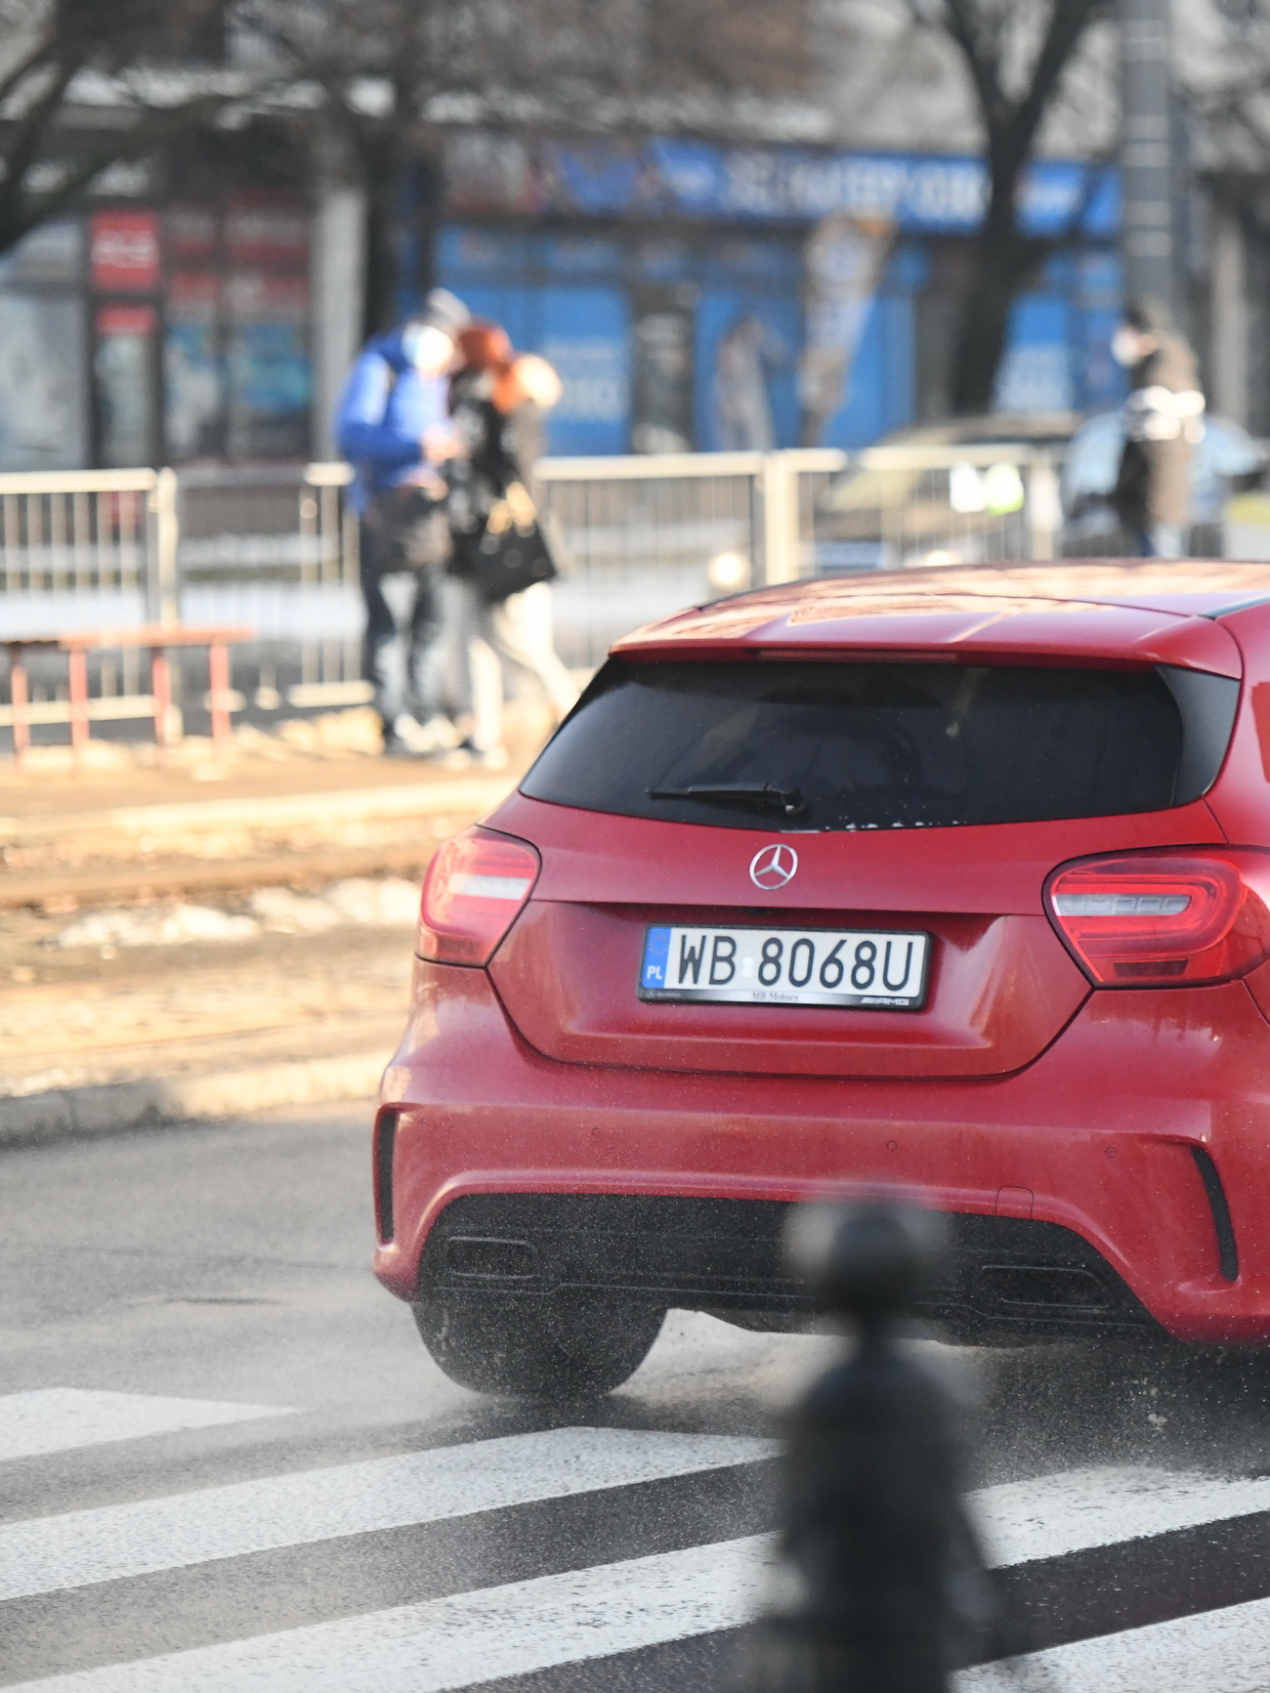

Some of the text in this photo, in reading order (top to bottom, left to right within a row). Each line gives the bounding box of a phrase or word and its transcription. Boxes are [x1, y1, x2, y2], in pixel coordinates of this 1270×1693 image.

[647, 966, 663, 980] PL
[679, 934, 914, 991] WB 8068U
